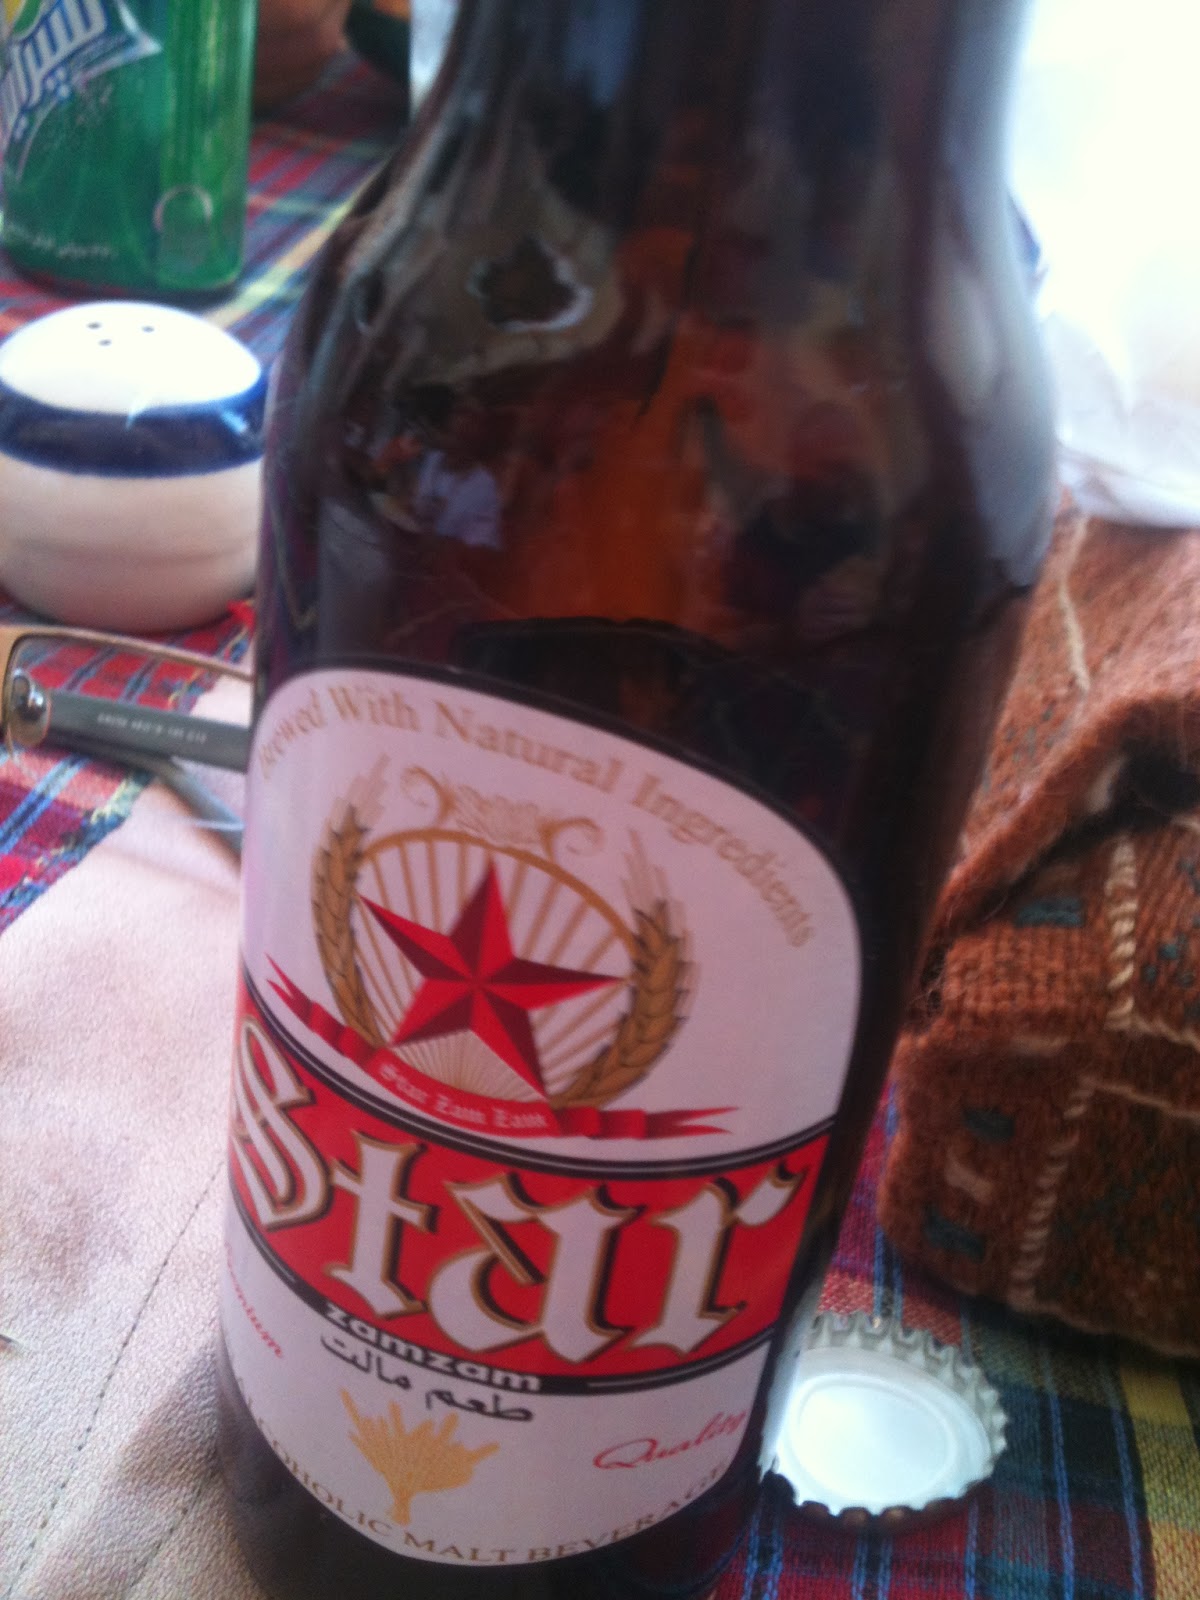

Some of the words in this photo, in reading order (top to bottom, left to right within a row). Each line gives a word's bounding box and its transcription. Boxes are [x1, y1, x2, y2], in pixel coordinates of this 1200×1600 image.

[328, 684, 422, 733] With
[432, 698, 623, 794] Natural
[631, 773, 816, 948] Ingredients
[230, 1013, 808, 1365] Star
[320, 1334, 413, 1392] مالت
[324, 1301, 542, 1392] zamzam
[424, 1388, 534, 1423] طعم
[403, 1528, 517, 1563] MALT
